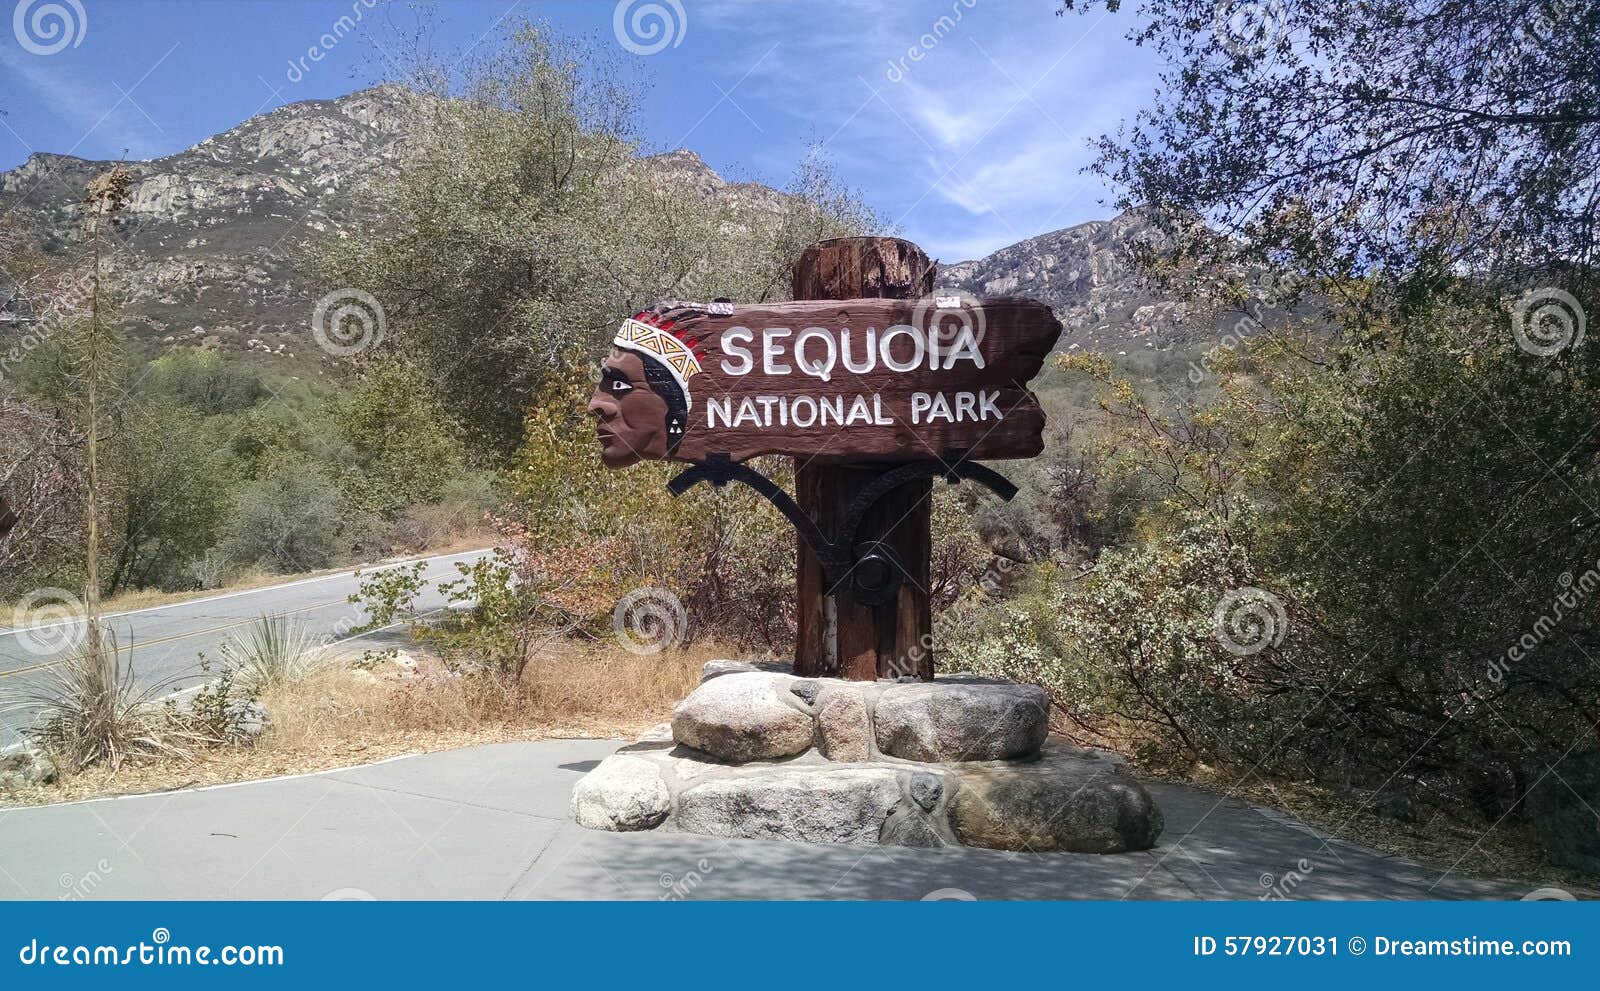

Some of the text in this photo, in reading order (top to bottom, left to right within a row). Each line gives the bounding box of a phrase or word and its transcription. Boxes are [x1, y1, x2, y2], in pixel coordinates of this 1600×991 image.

[720, 324, 986, 382] SEQUOIA
[706, 390, 1004, 429] NATIONAL PARK
